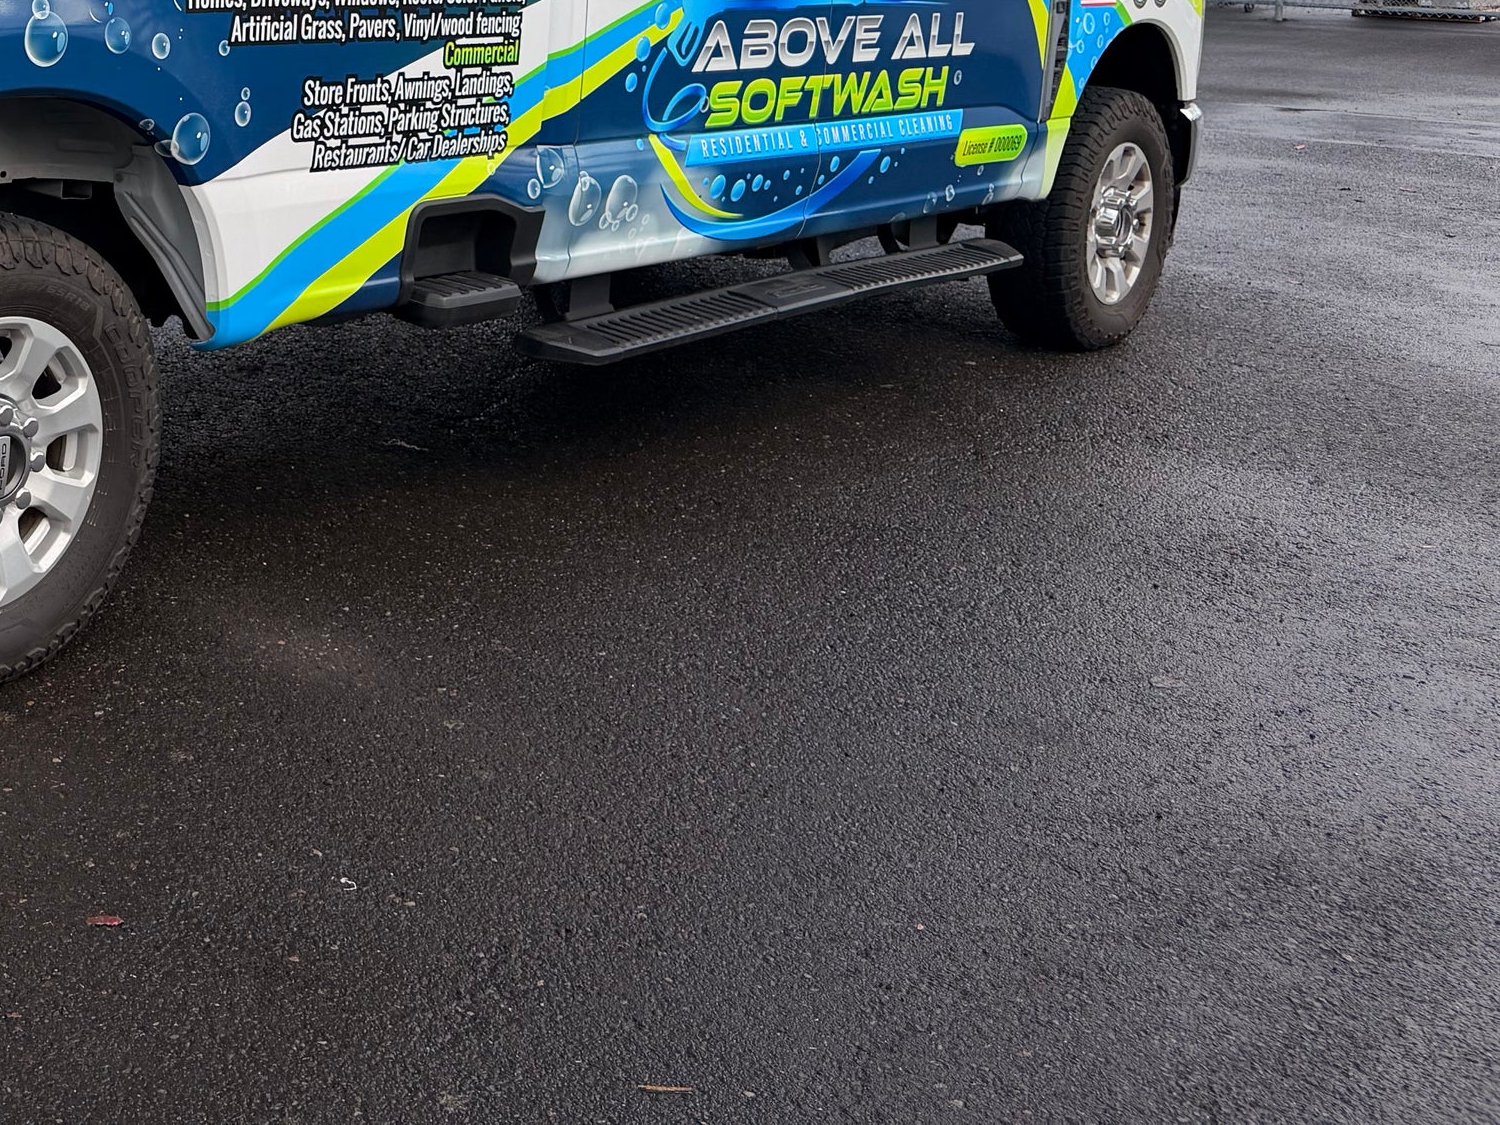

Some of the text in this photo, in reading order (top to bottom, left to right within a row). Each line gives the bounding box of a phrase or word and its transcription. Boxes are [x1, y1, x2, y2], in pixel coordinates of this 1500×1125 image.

[231, 10, 521, 43] Artificial Grass, Pavers, Vinyl/wood fencing
[691, 12, 975, 73] ABOVE ALL
[445, 39, 519, 67] Commercial
[304, 73, 513, 106] Store Fronts, Awnings, Landings,
[705, 65, 949, 128] SOFTWASH
[293, 103, 510, 139] Gas Stations, Parking Structures,
[701, 114, 954, 159] RESIDENTIAL & COMMERCIAL CLEANING
[407, 136, 431, 160] Car
[432, 132, 506, 159] Dealerships
[962, 140, 988, 156] License
[105, 324, 145, 468] COOPER
